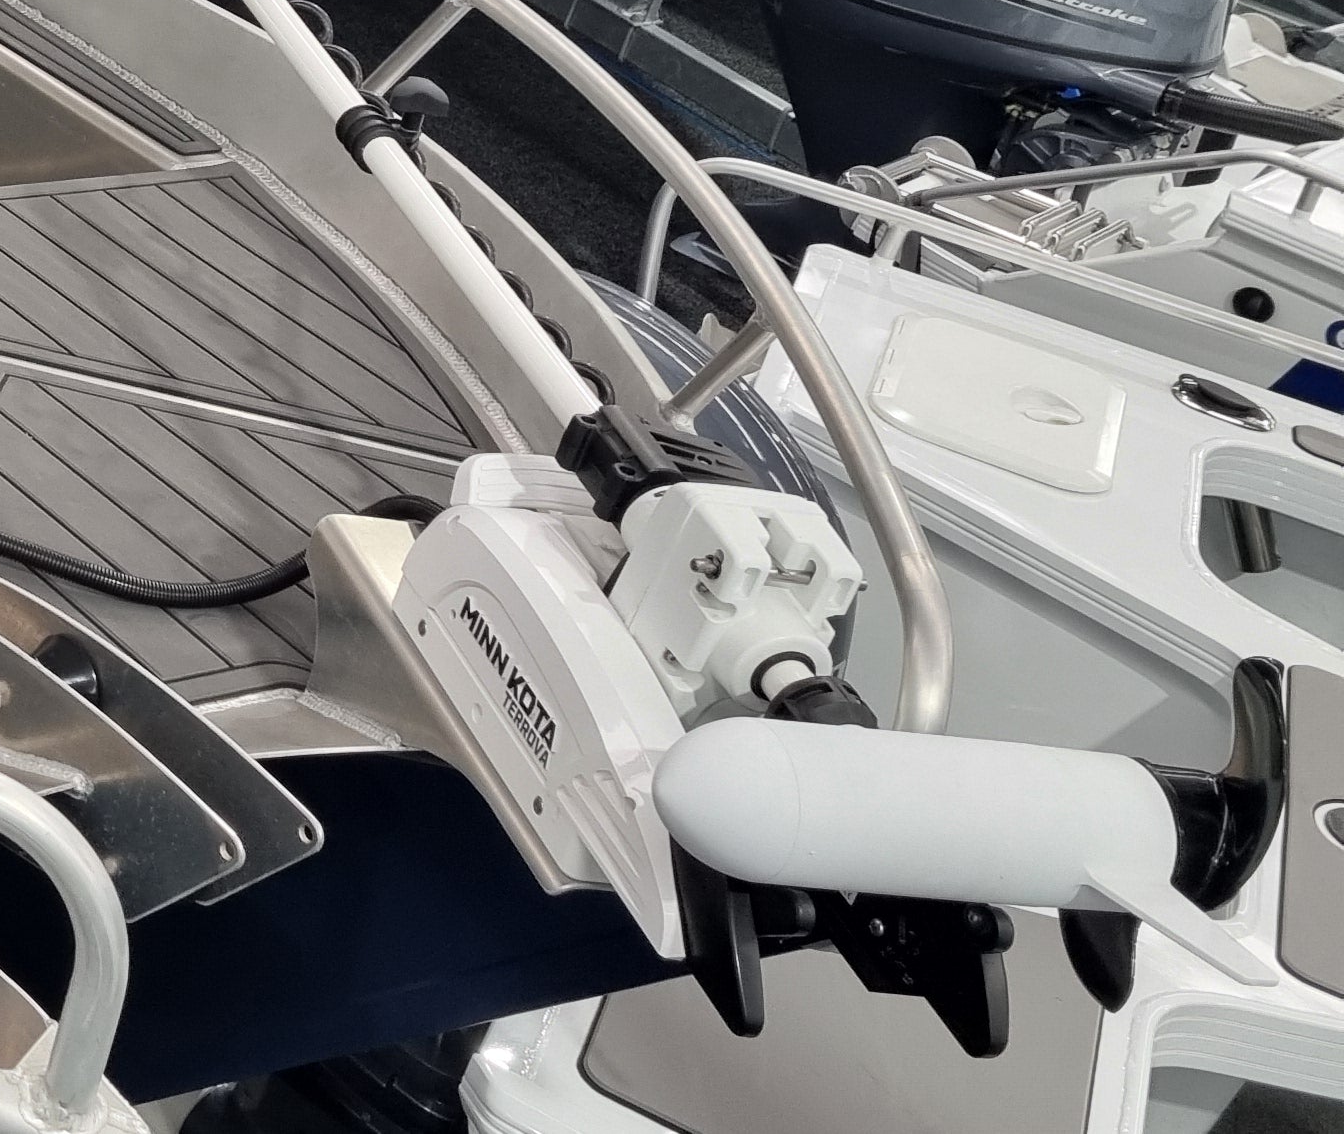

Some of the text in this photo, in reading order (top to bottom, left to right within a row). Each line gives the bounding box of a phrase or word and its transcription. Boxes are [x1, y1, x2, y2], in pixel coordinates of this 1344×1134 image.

[460, 596, 557, 752] MINN KOTA
[502, 690, 550, 769] TERROVA
